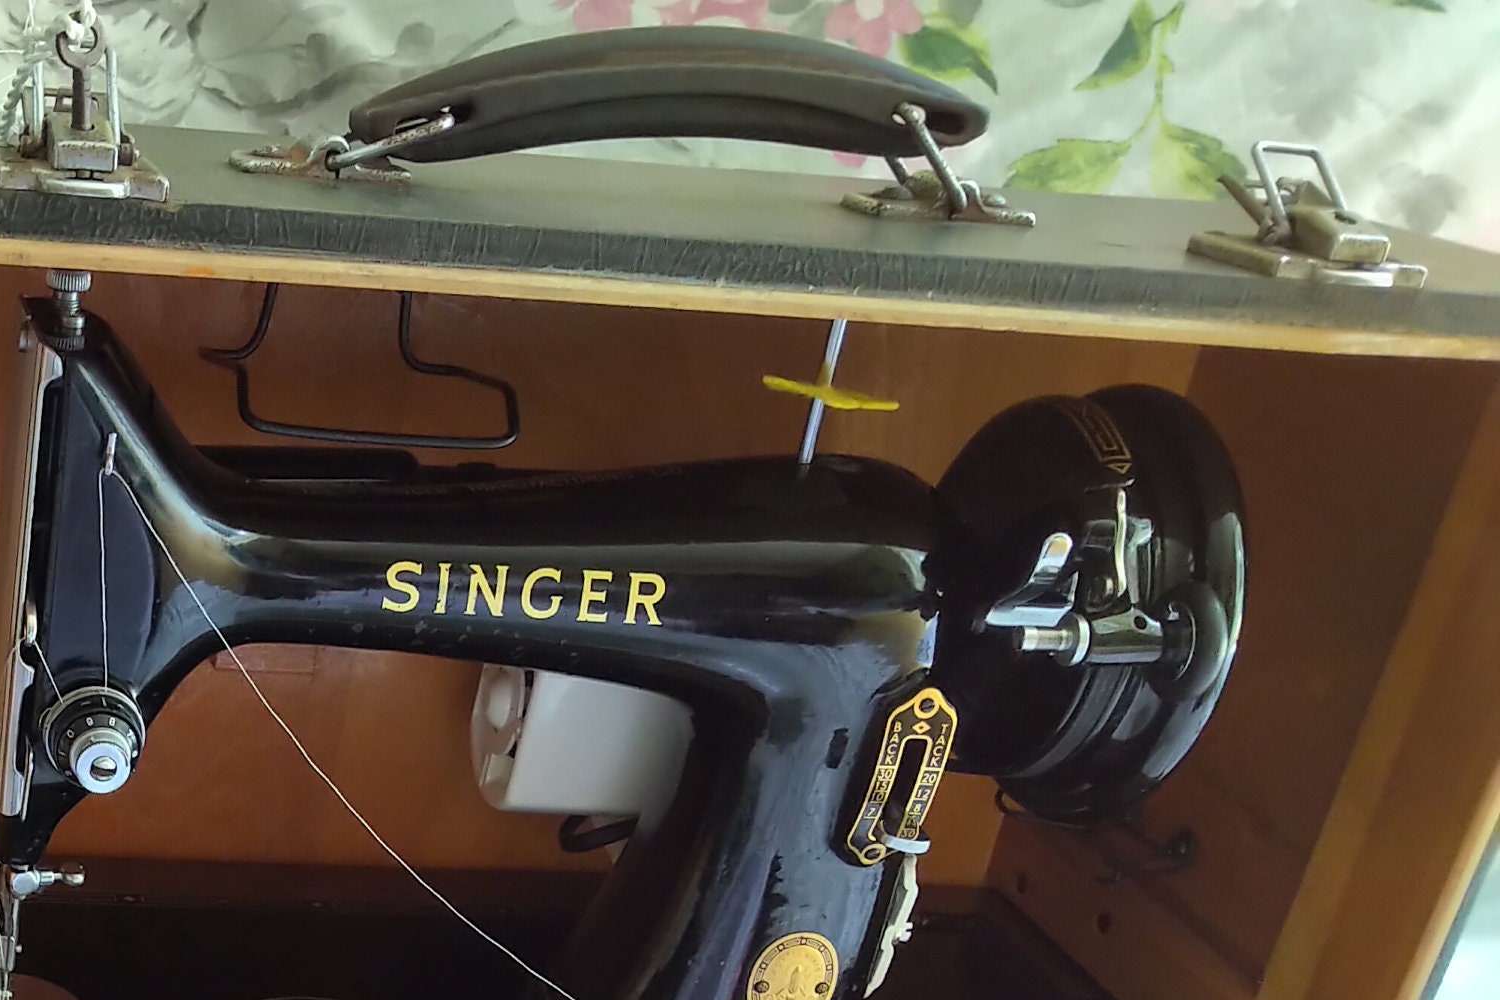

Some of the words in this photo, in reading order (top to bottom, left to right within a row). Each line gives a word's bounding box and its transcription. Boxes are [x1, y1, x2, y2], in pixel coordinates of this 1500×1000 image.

[381, 560, 667, 627] SINGER
[885, 721, 902, 765] BACK
[930, 723, 949, 767] TACK
[877, 769, 893, 780] 30
[921, 773, 937, 784] 20
[874, 781, 888, 791] 15
[916, 789, 931, 799] 12
[867, 807, 877, 817] 7
[913, 803, 922, 813] 8
